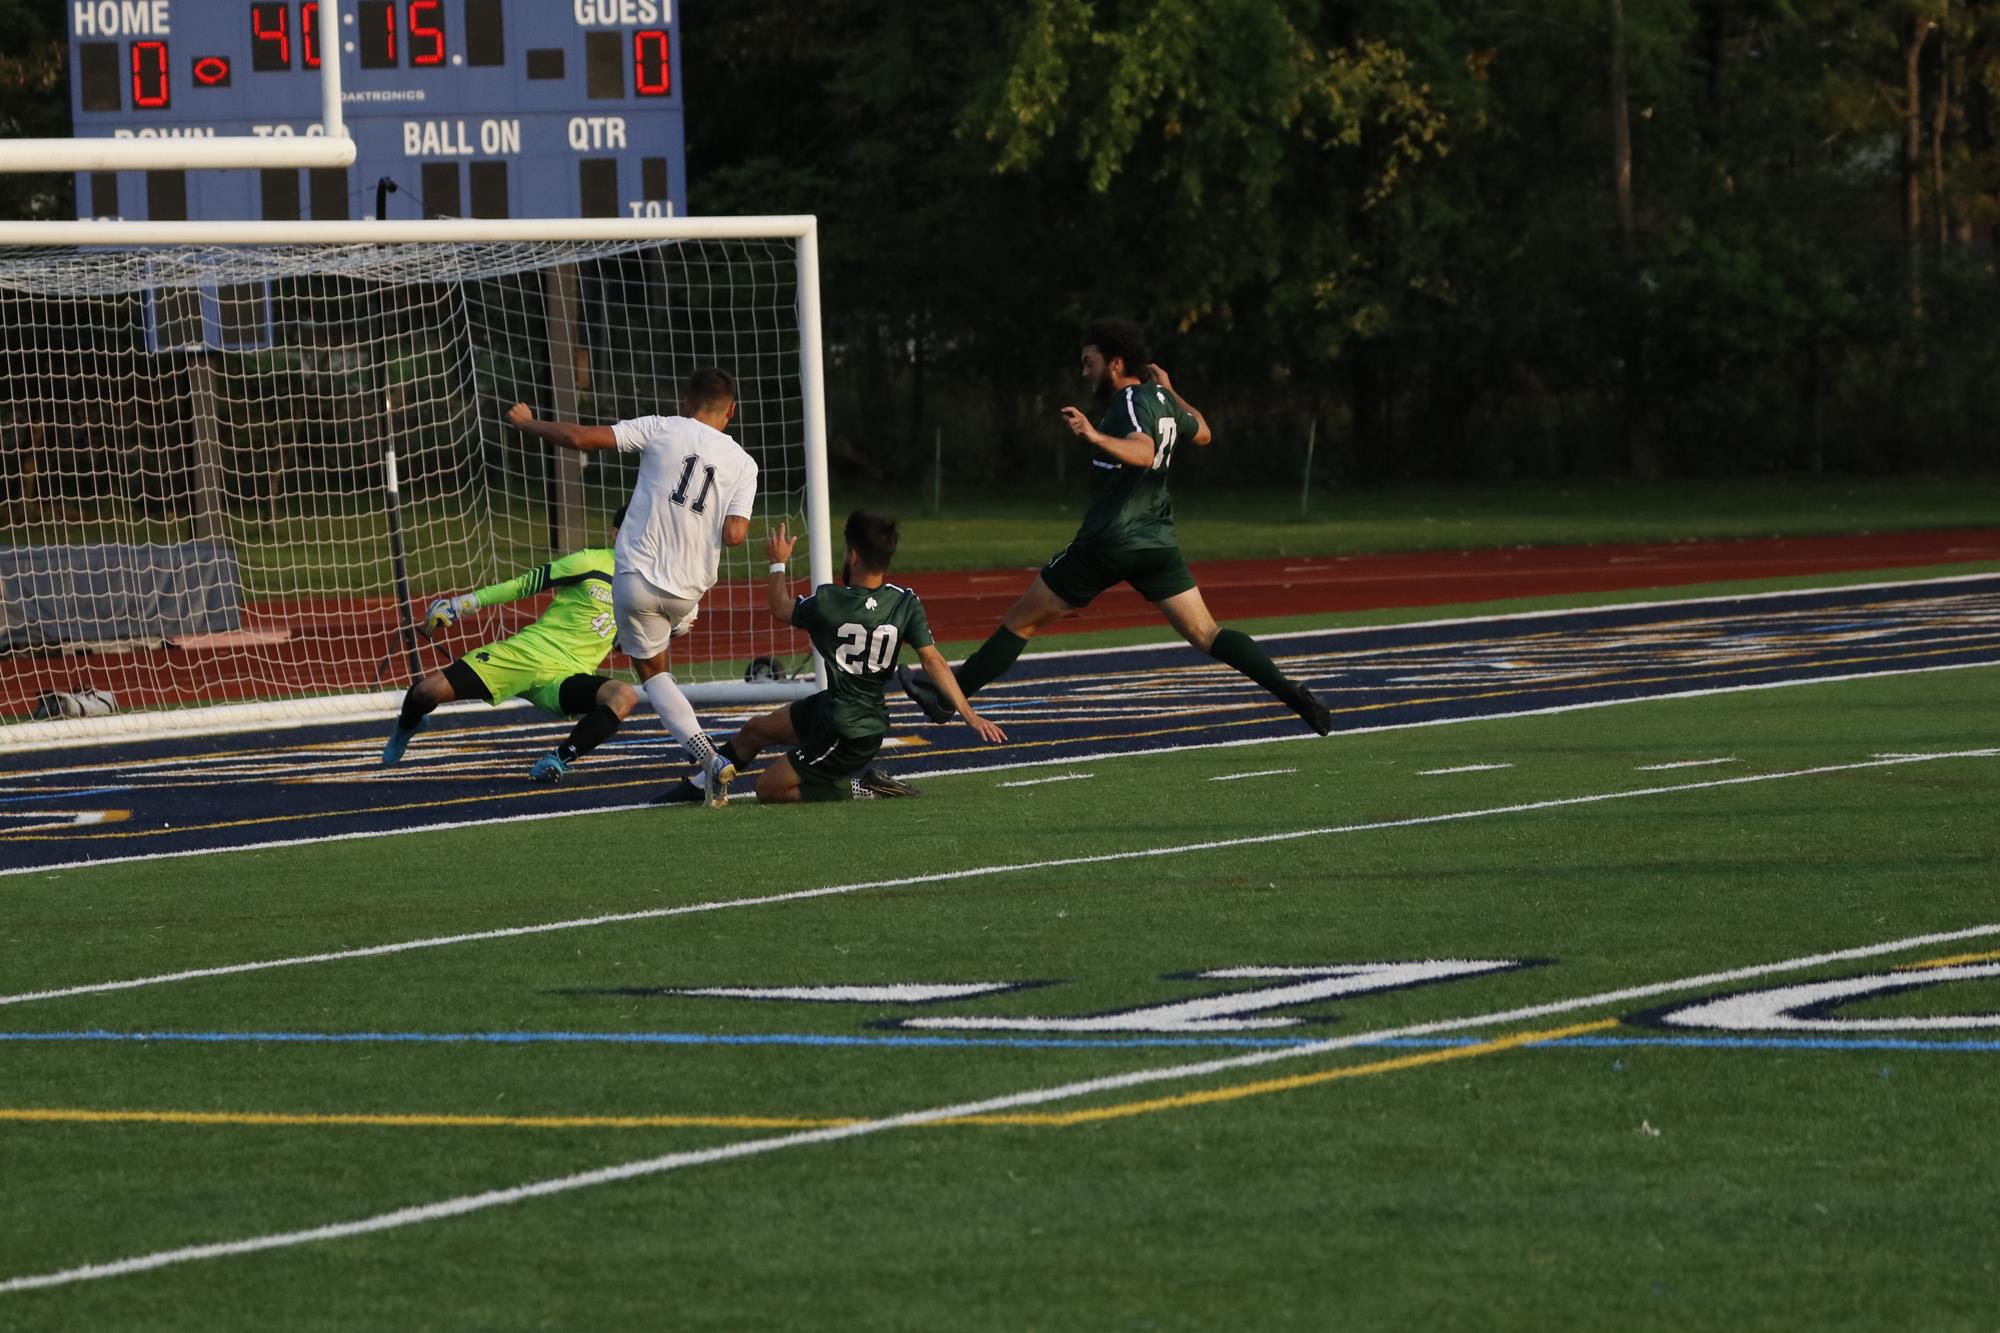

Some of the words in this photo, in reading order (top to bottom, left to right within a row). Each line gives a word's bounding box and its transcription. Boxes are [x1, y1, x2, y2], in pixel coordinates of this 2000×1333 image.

[74, 0, 170, 36] HOME
[132, 42, 169, 107] 0
[634, 31, 670, 94] 0
[403, 120, 474, 156] BALL
[480, 119, 521, 155] ON
[568, 117, 627, 150] QTR
[669, 454, 717, 515] 11
[835, 622, 898, 675] 20
